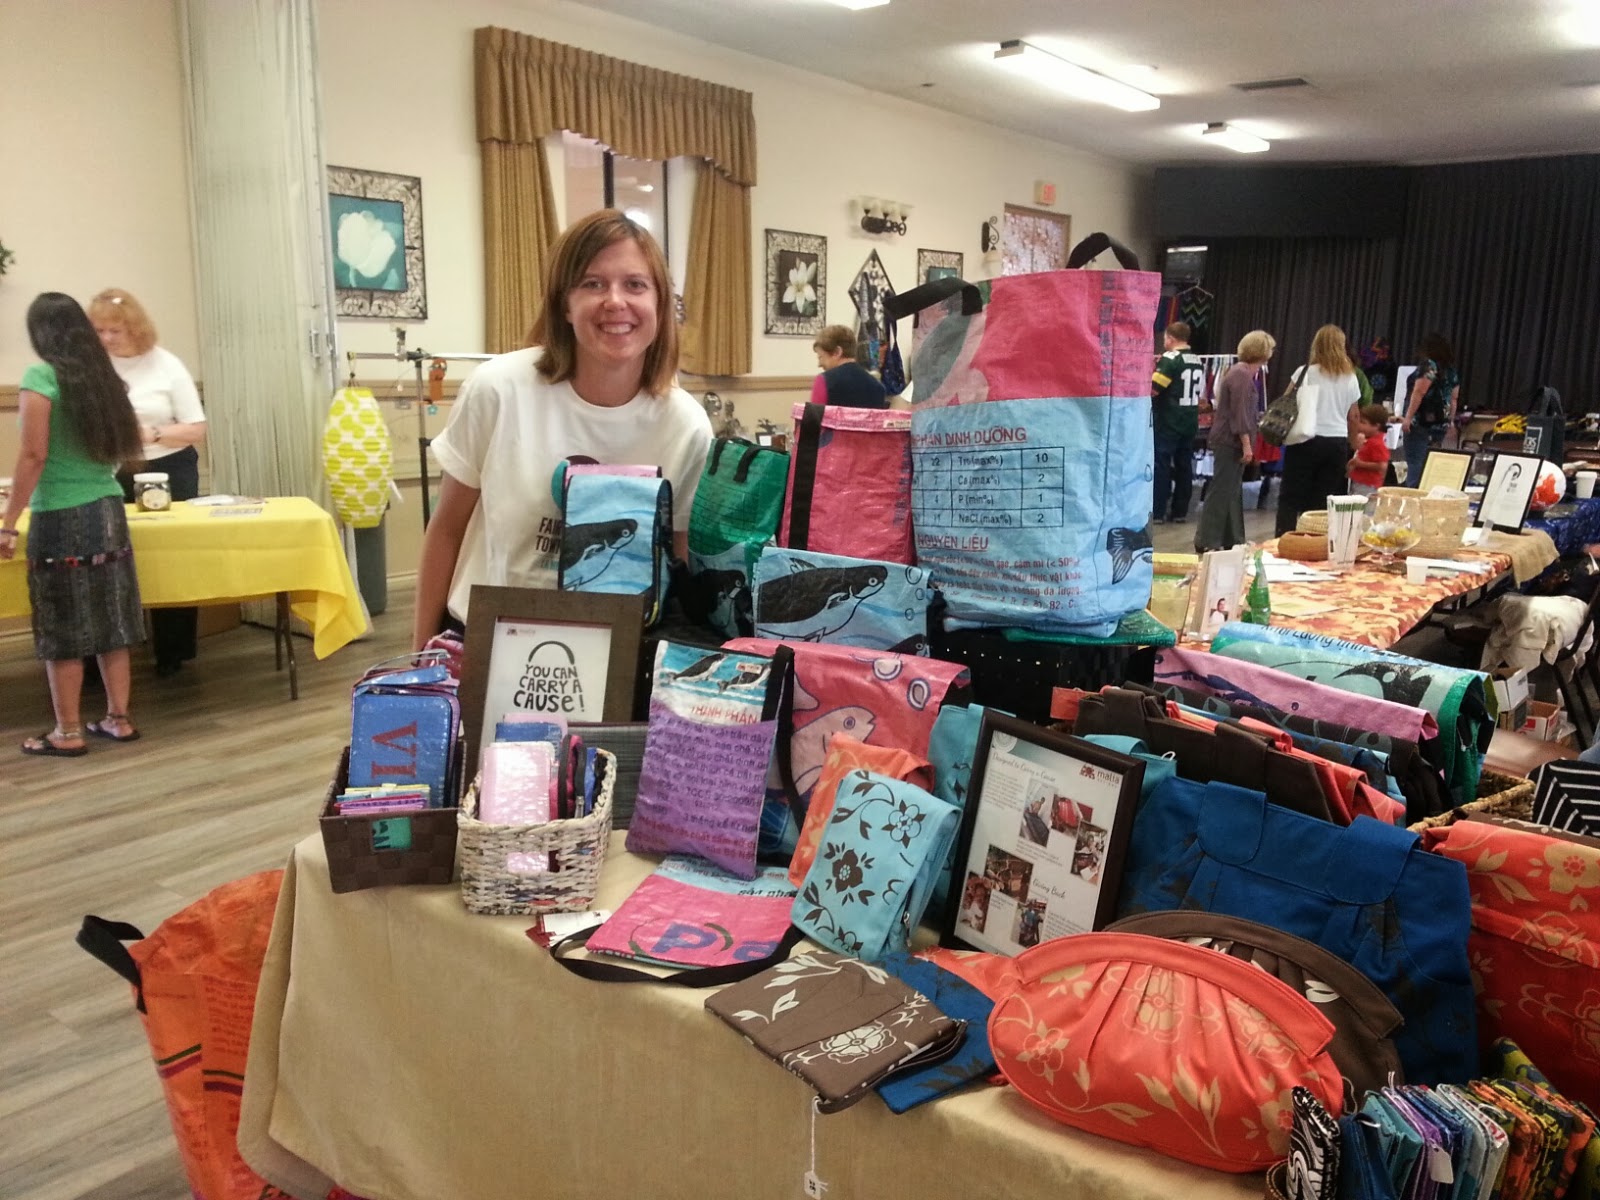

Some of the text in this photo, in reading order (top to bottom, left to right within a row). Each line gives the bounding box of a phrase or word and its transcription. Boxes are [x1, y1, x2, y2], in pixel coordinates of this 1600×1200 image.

[1179, 369, 1206, 406] 12
[1035, 453, 1049, 463] 10
[1038, 473, 1045, 483] 2
[1038, 494, 1043, 502] 1
[1037, 514, 1044, 523] 2
[526, 664, 578, 679] YOU CAN
[519, 675, 582, 694] CARRY A
